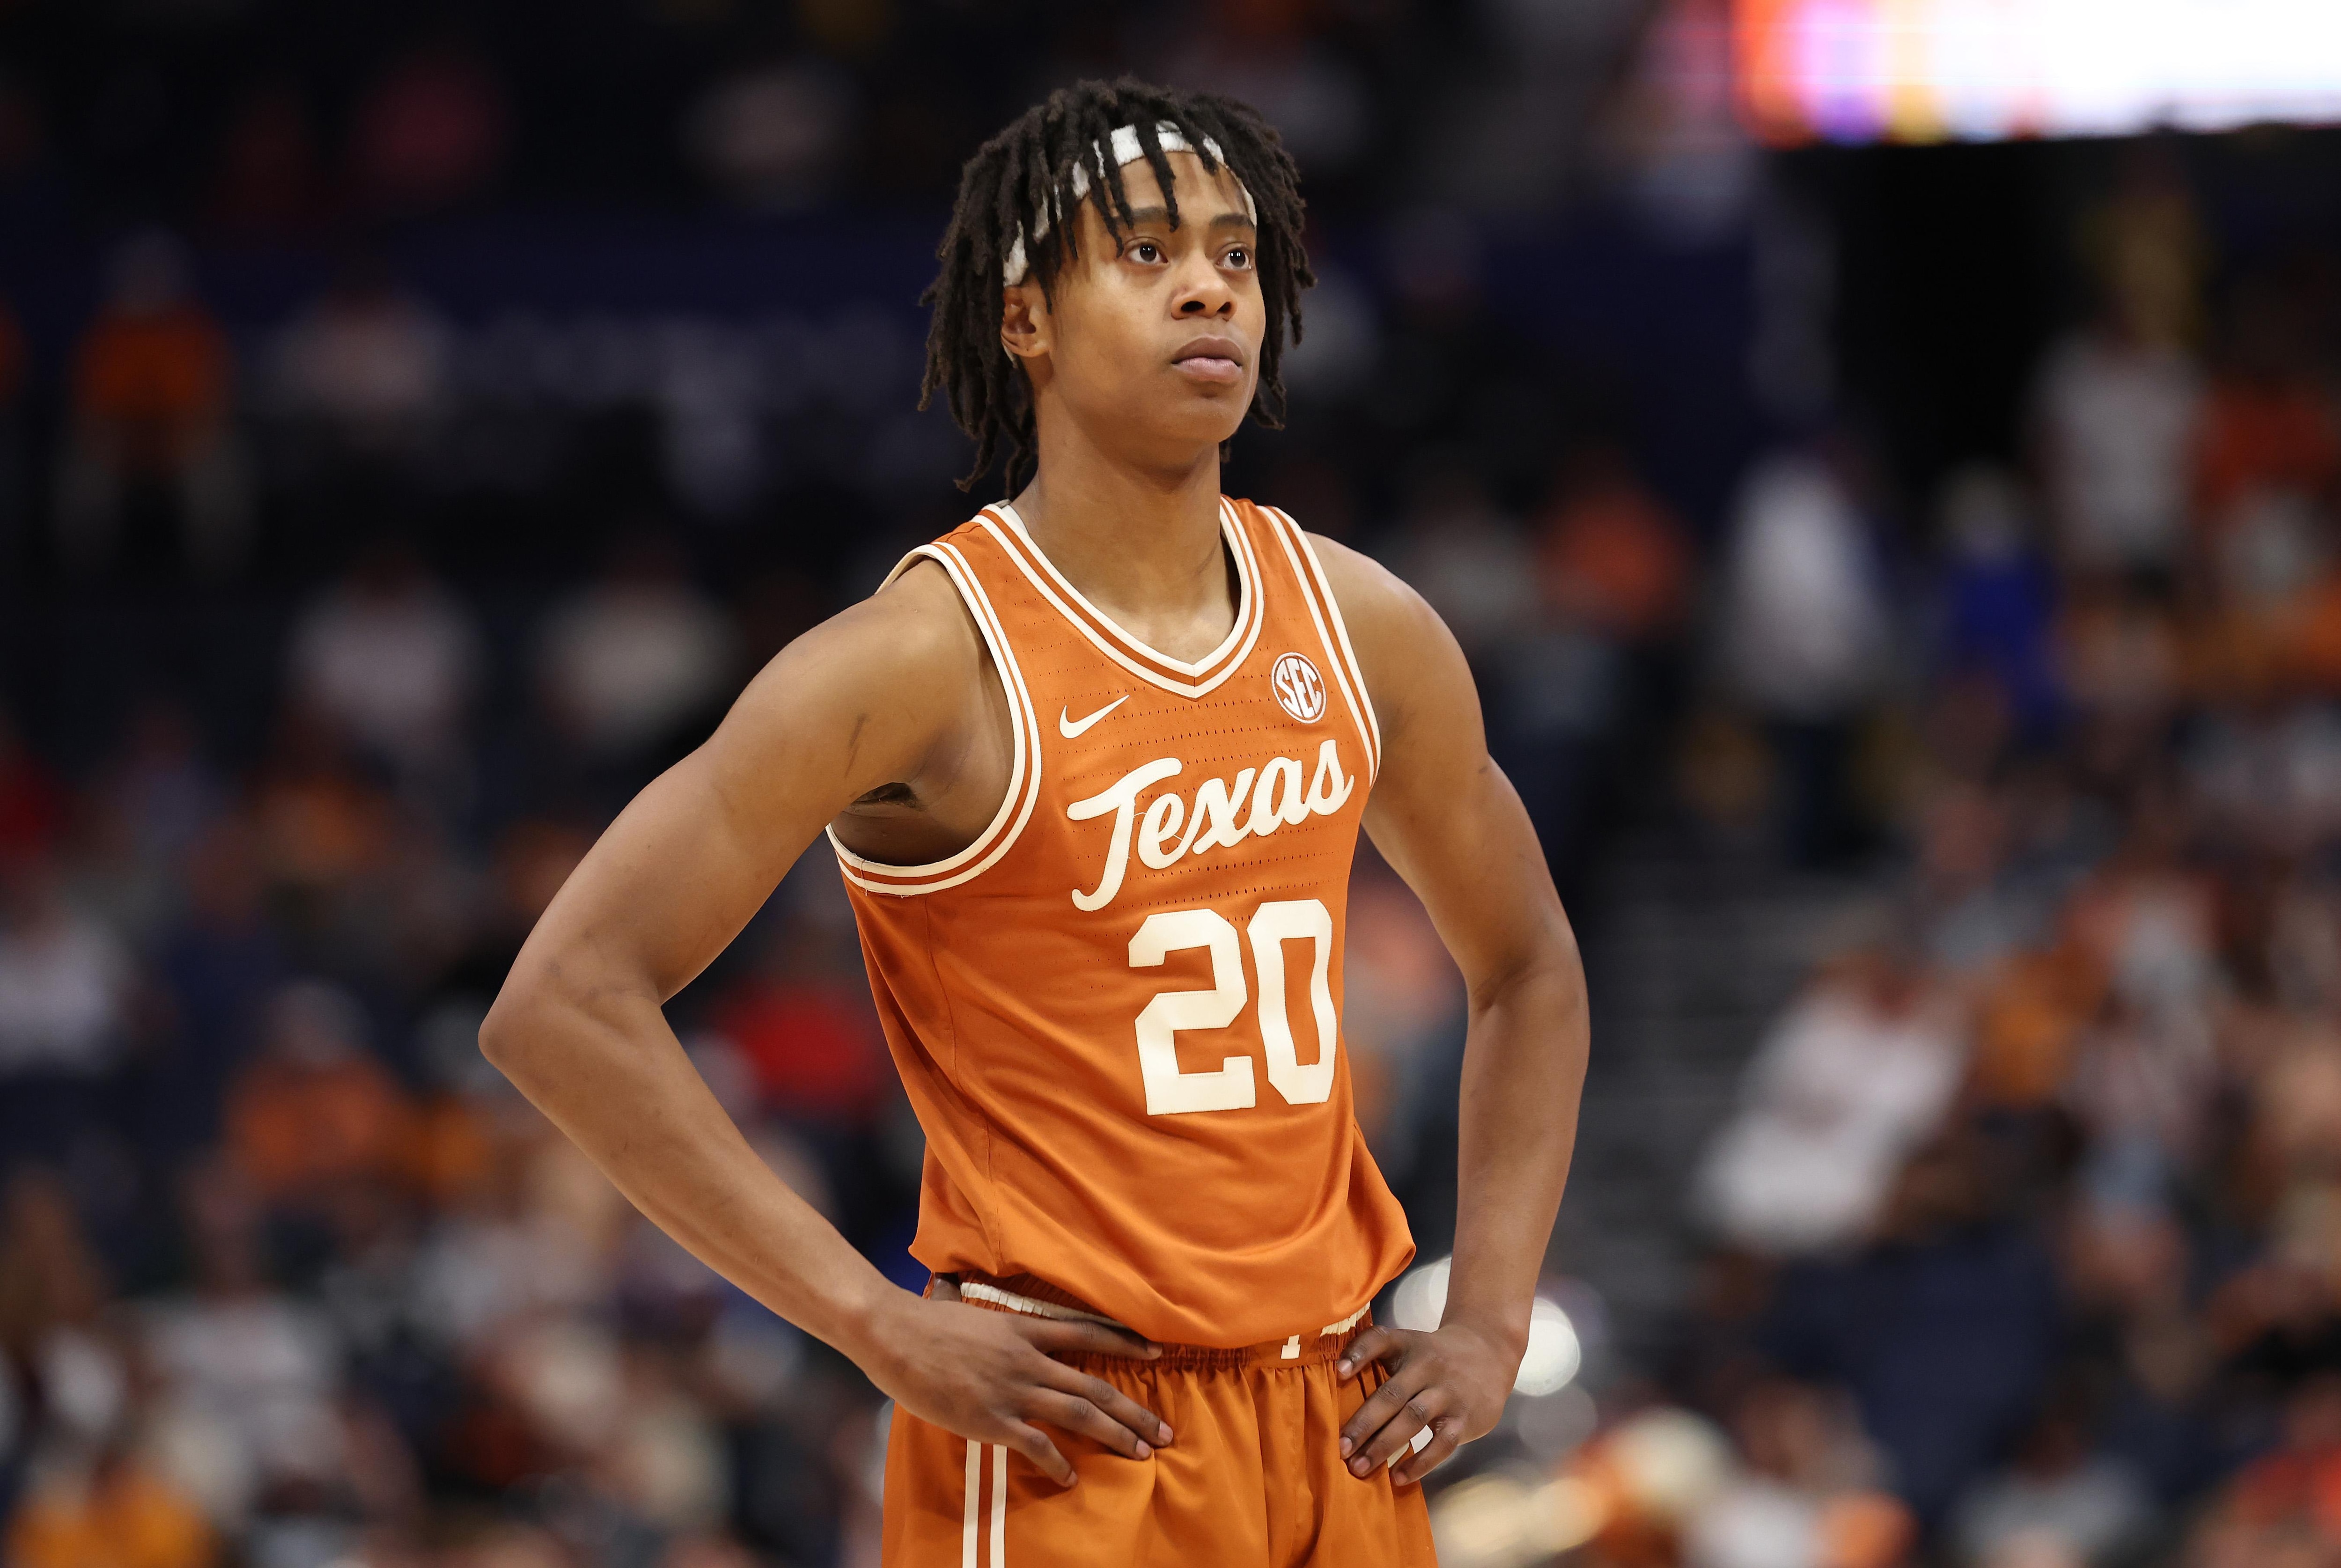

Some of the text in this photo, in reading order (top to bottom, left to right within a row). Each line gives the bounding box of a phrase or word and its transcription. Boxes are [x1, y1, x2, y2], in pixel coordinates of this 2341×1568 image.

[1276, 658, 1322, 718] SEC
[1067, 739, 1354, 911] Texas
[1128, 899, 1337, 1115] 20
